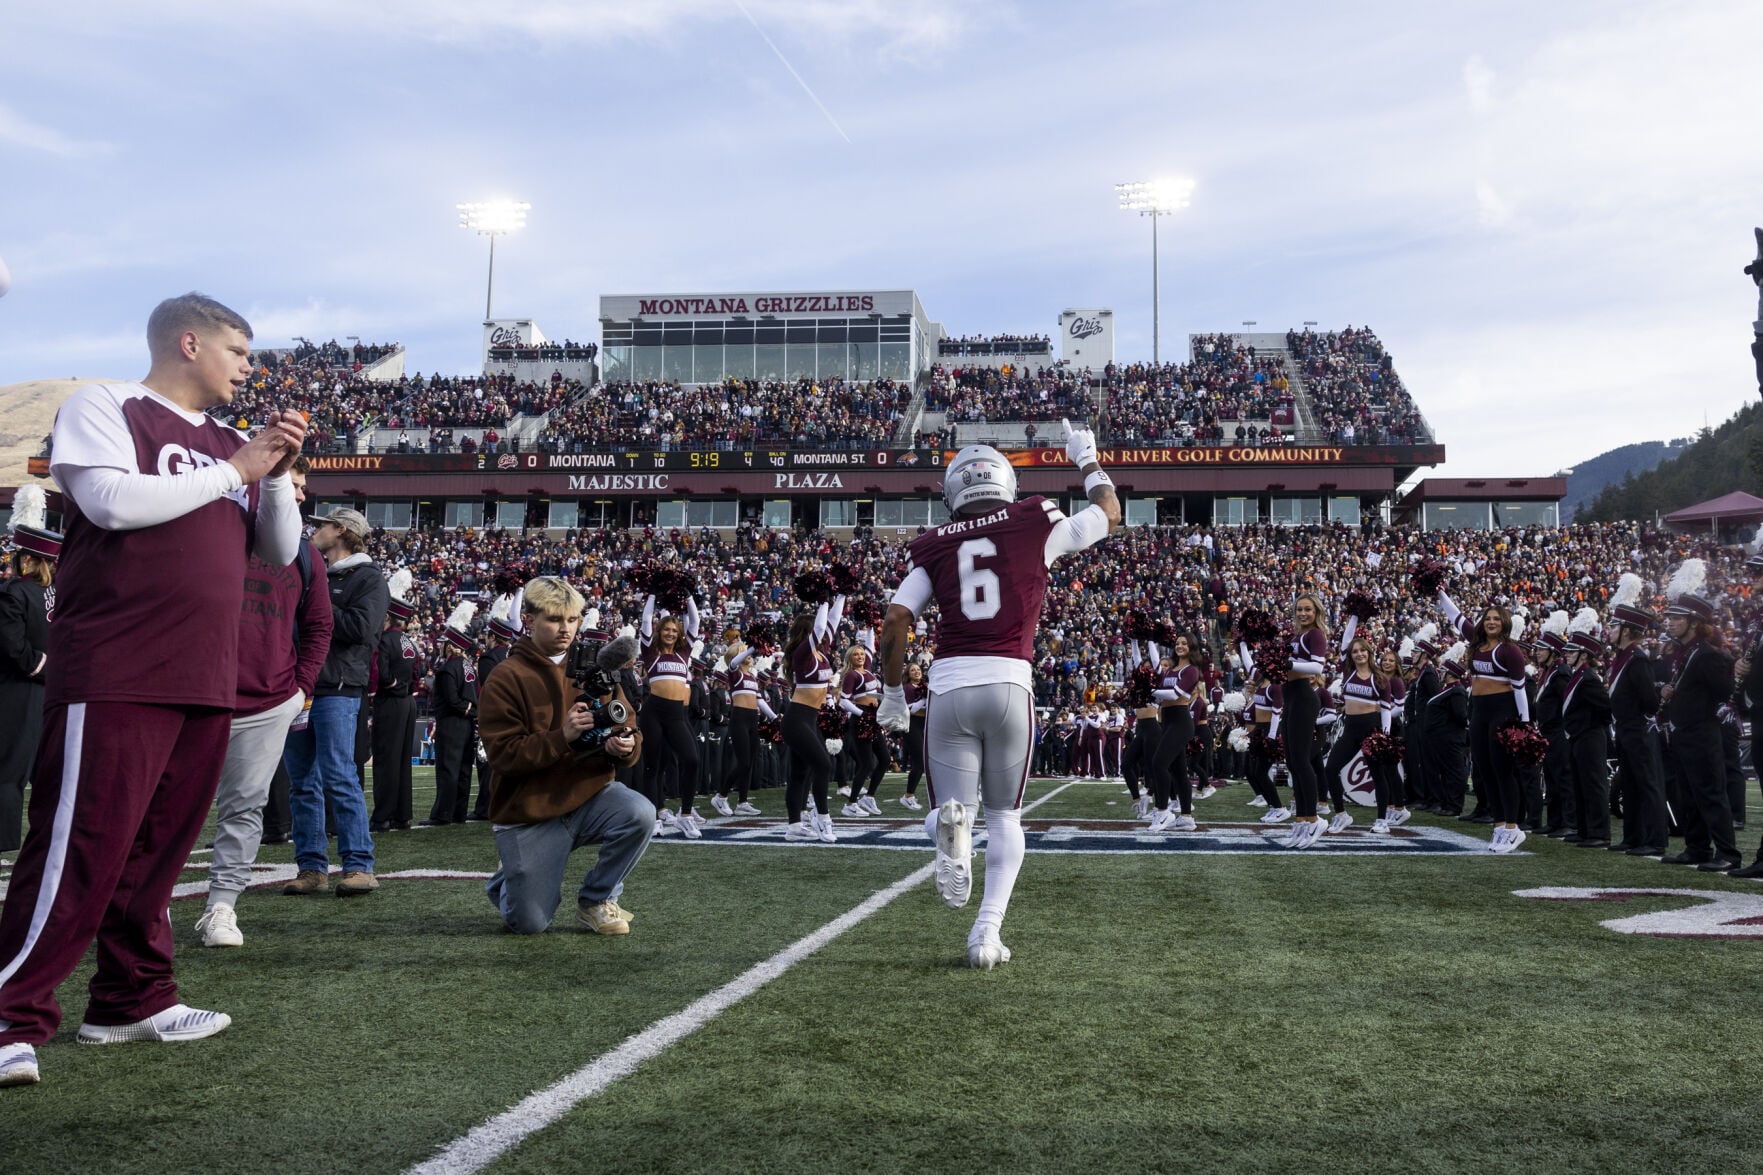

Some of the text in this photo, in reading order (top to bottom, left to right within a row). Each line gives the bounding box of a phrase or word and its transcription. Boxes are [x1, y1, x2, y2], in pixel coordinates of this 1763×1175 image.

[639, 295, 874, 315] MONTANA GRIZZLIES
[1069, 317, 1103, 340] Griz
[490, 326, 521, 345] Griz
[528, 455, 537, 468] 0
[549, 455, 616, 468] MONTANA
[690, 452, 719, 467] 9:19
[744, 457, 752, 467] 4
[769, 457, 784, 467] 40
[793, 454, 866, 465] MONTANA ST.
[877, 452, 887, 465] 0
[931, 455, 939, 466] 0
[1122, 450, 1173, 463] RIVER
[1177, 449, 1224, 462] GOLF
[1228, 448, 1343, 462] COMMUNITY
[305, 456, 383, 469] MMUNITY
[478, 459, 485, 469] 2
[630, 458, 634, 468] 1
[653, 458, 665, 468] 10
[568, 474, 669, 490] MAJESTIC
[774, 473, 843, 488] PLAZA
[957, 537, 1001, 621] 6
